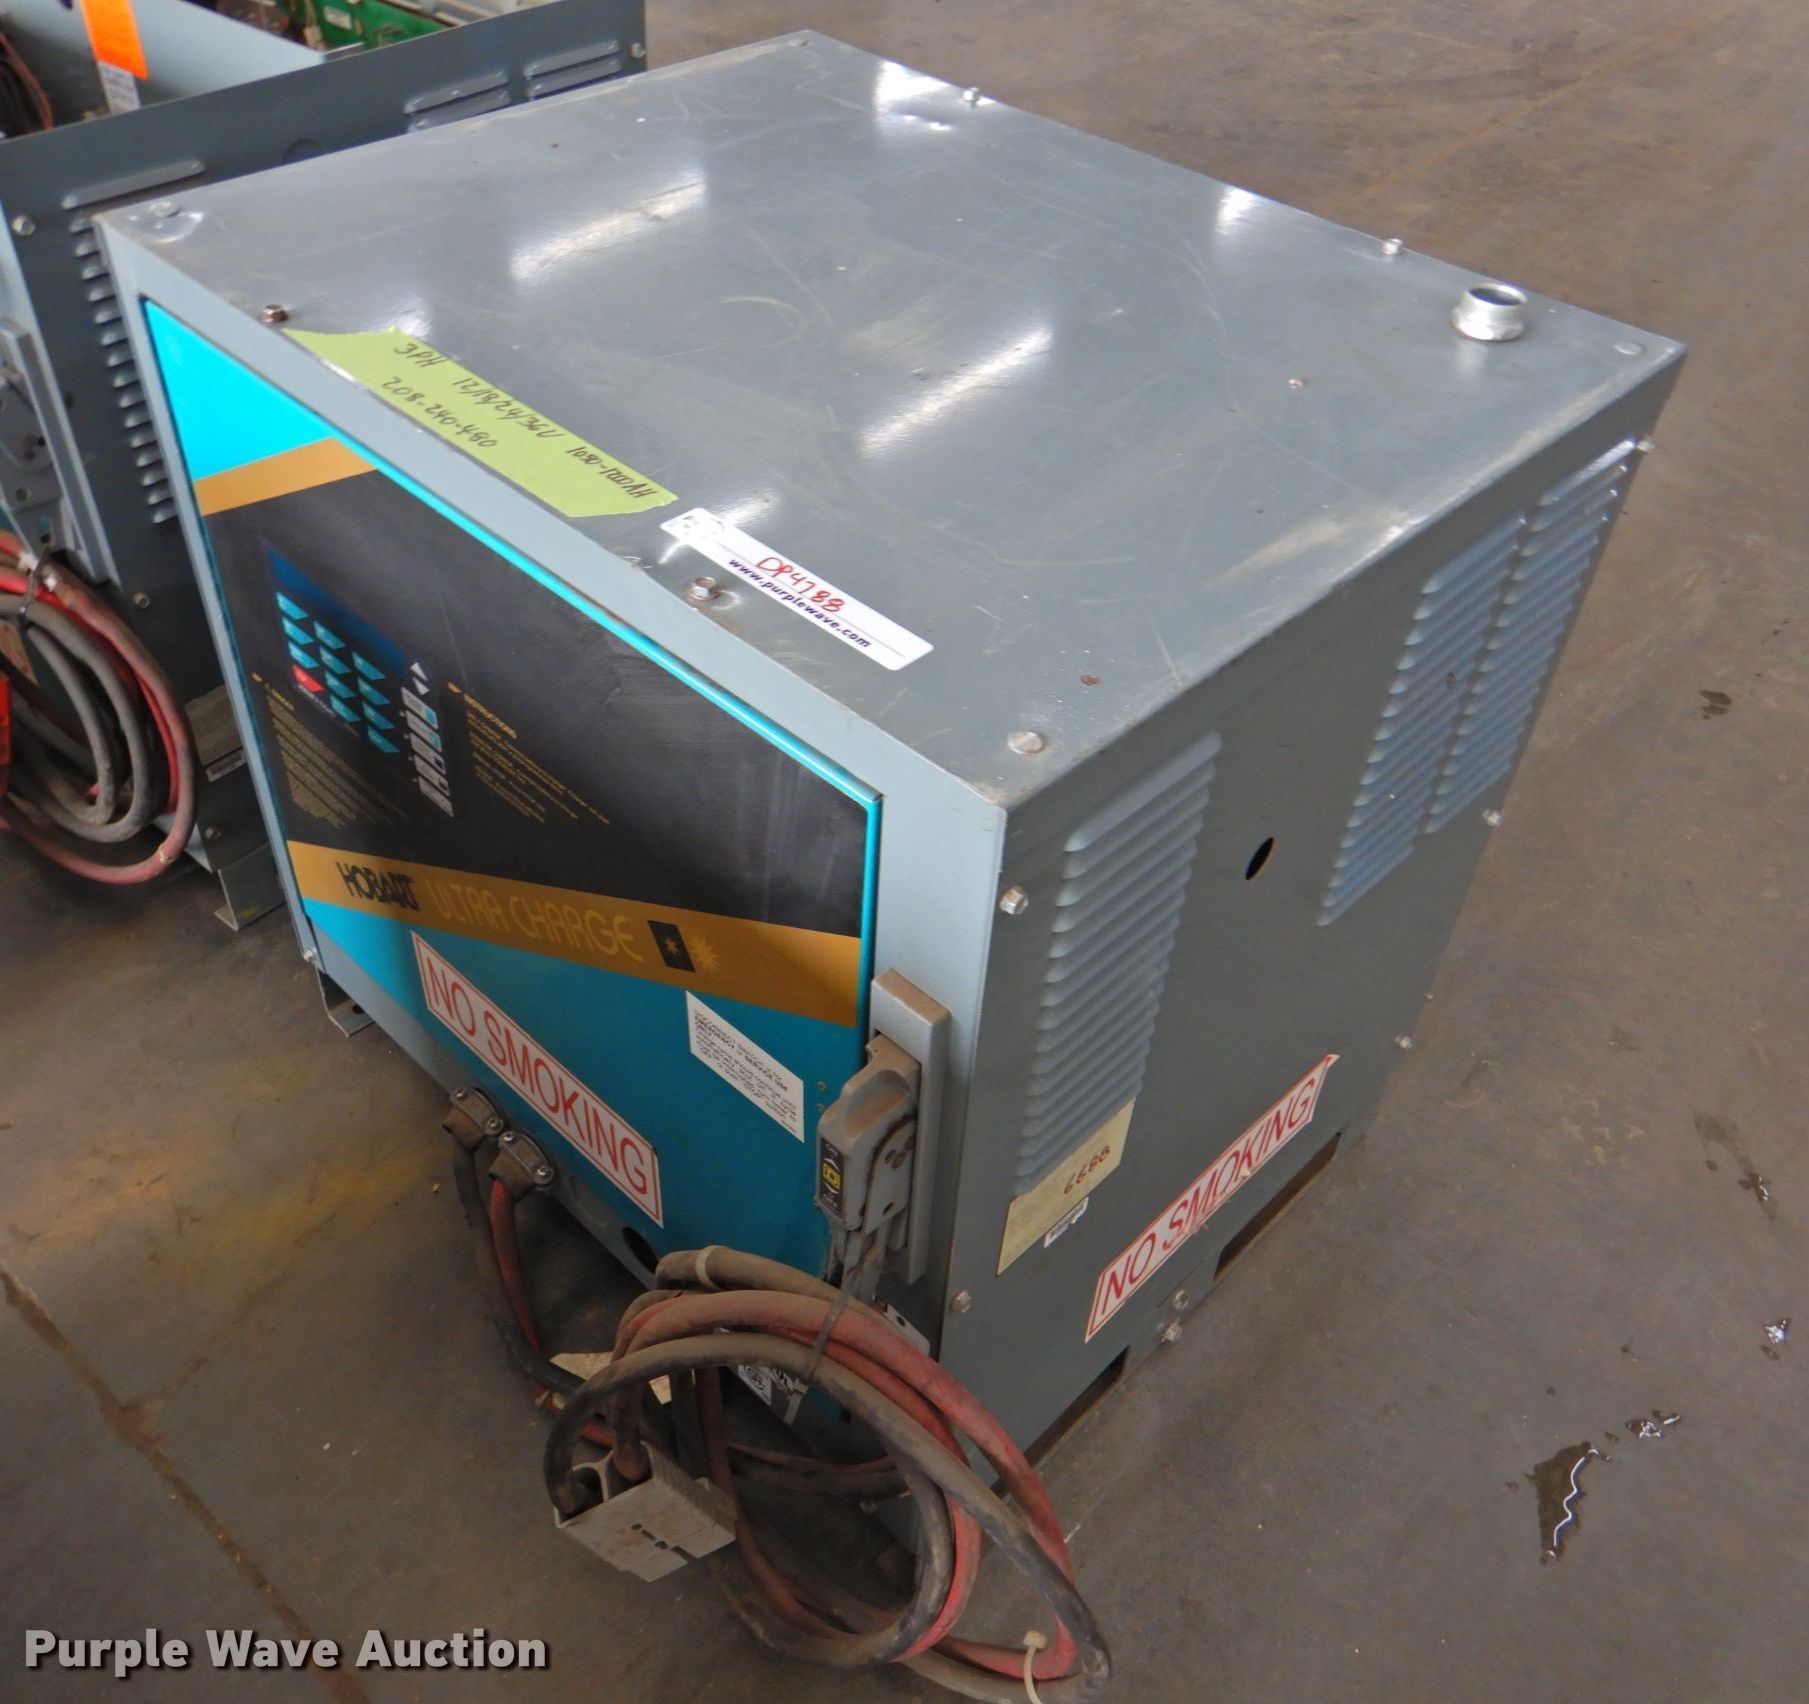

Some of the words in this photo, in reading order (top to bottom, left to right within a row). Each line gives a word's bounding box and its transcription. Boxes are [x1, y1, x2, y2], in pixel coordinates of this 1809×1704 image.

[728, 559, 872, 648] www.purplewave.com
[756, 557, 846, 613] DP4788
[336, 861, 421, 912] HOBART
[425, 879, 510, 933] ULTRA
[510, 895, 643, 963] CHARGE
[427, 966, 478, 1036] NO
[483, 1010, 648, 1197] SMOKING
[1100, 1233, 1156, 1316] NO
[1163, 1077, 1316, 1251] SMOKING
